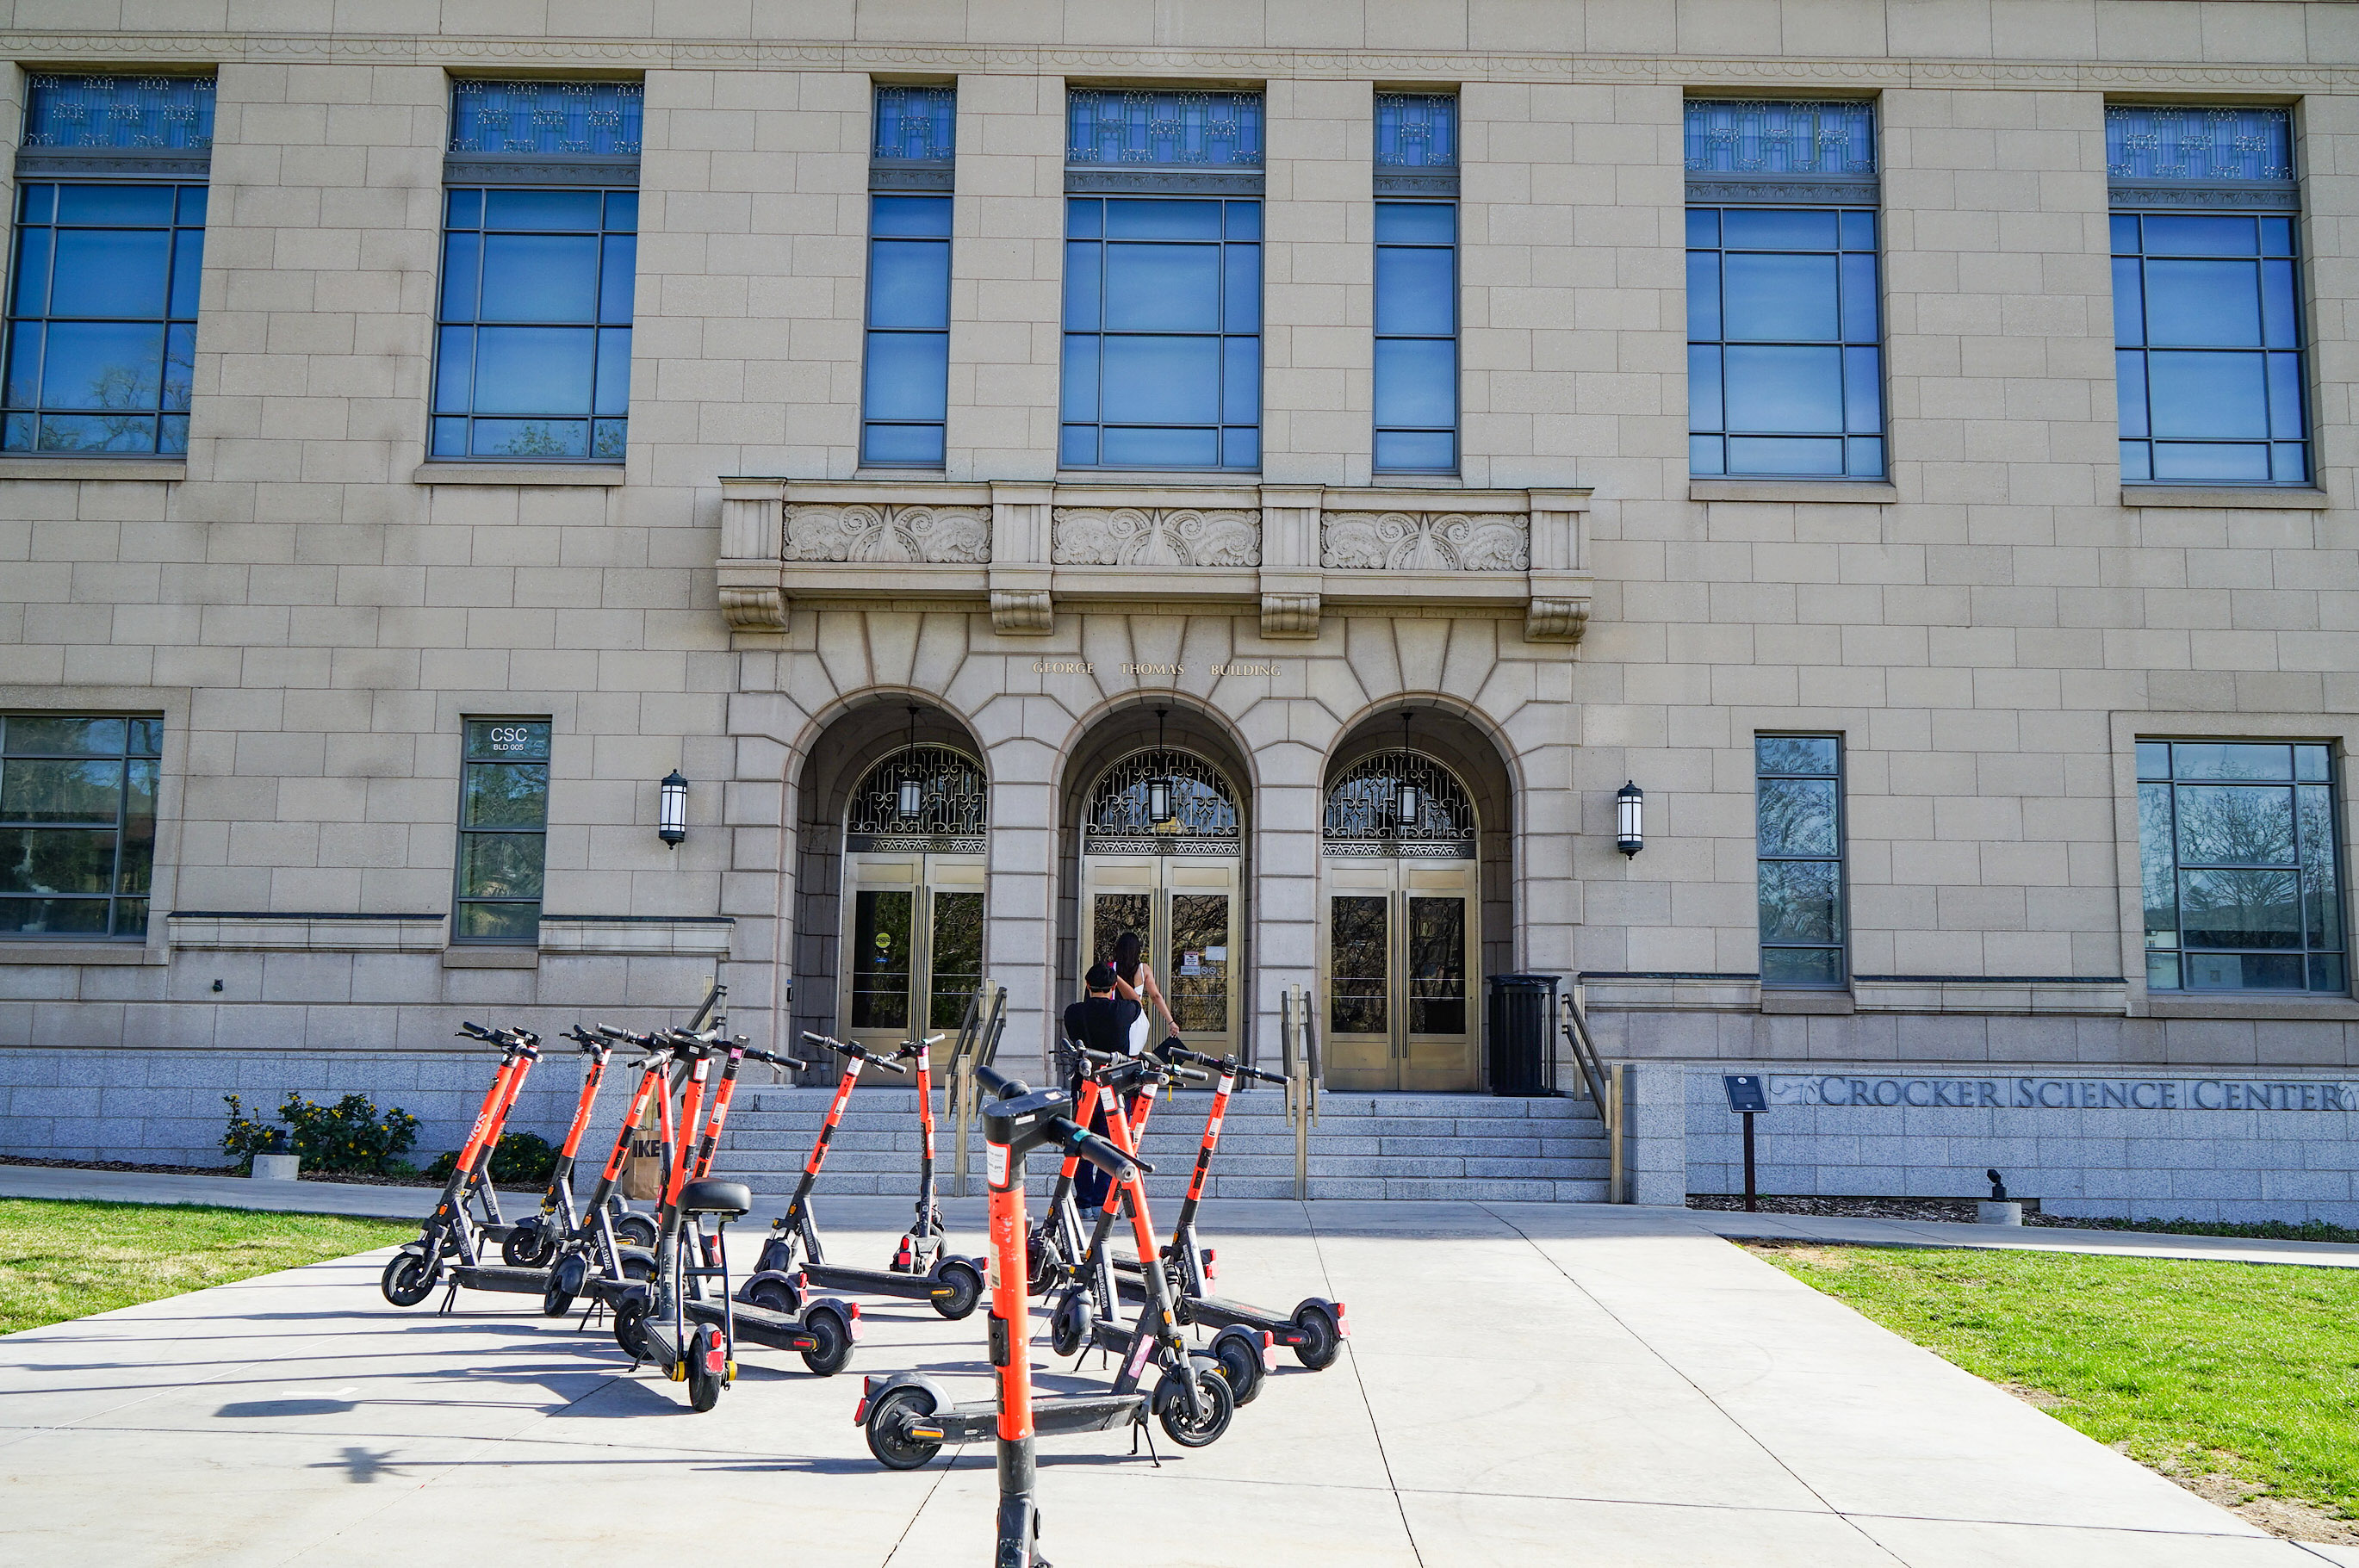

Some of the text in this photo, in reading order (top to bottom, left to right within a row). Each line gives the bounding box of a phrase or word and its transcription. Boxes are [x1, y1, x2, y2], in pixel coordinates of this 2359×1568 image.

[1033, 661, 1282, 678] GEORGE THOMAS BUILDING
[491, 728, 528, 742] CSC
[631, 1139, 661, 1158] IKE
